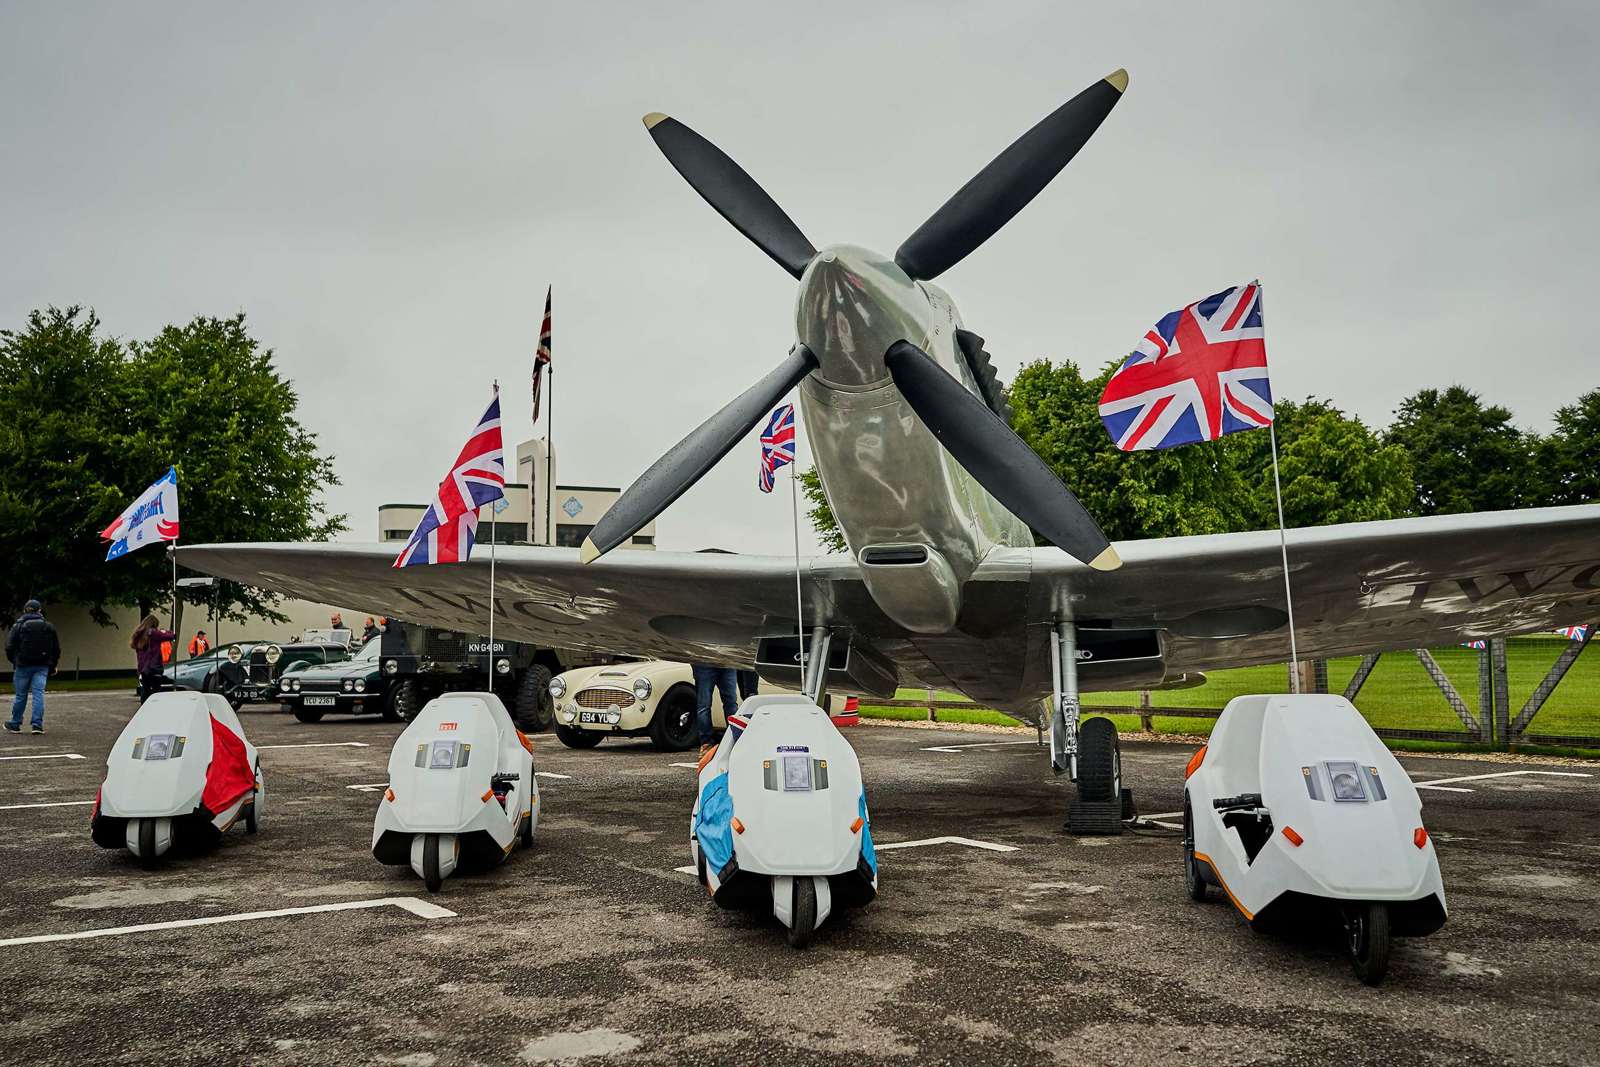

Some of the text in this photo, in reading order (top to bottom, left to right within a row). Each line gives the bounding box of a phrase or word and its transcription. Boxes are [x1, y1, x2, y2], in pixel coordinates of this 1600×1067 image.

[392, 586, 586, 626] IWC
[581, 712, 609, 723] 694 YU
